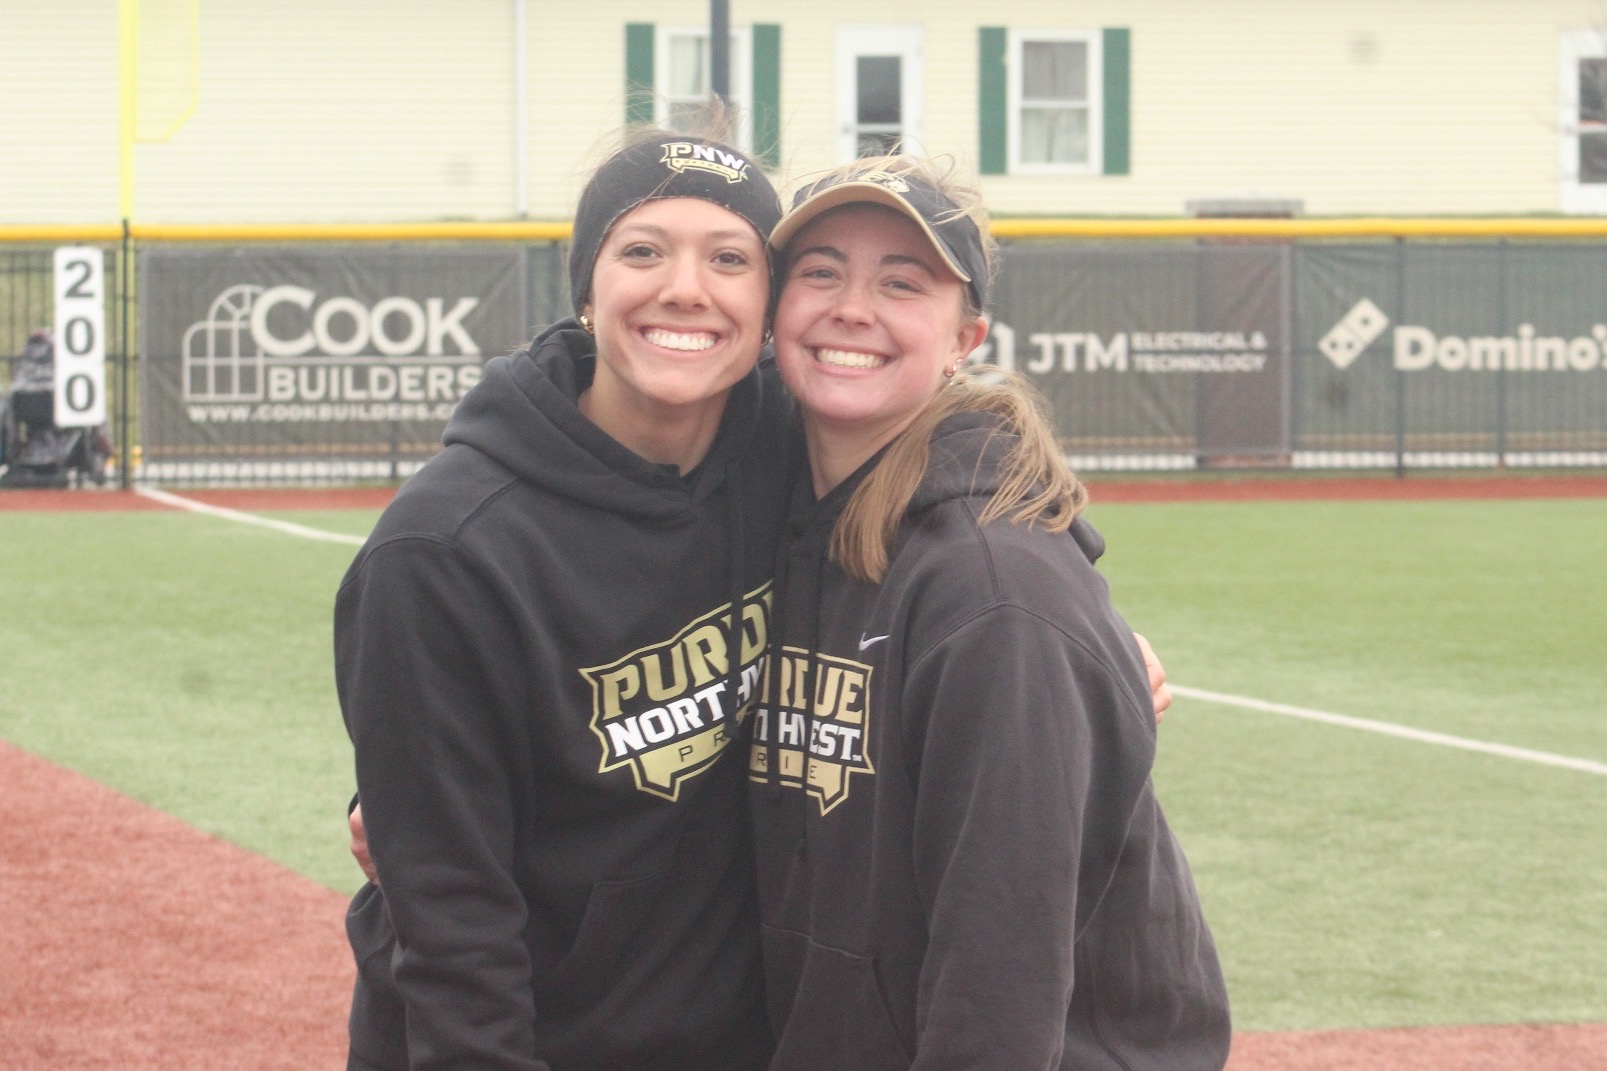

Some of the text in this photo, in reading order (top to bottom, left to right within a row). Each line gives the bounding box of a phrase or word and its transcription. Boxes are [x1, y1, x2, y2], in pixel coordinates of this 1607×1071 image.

[669, 144, 744, 170] PNW
[250, 286, 480, 355] COOK
[1027, 332, 1128, 374] JTM
[1131, 331, 1247, 349] ELECTRICAL
[1393, 323, 1607, 371] Domino'
[1133, 354, 1267, 372] TECHNOLOGY
[268, 366, 482, 400] BUILDERS
[188, 403, 456, 422] WWW.COOKBUILDERS.C
[600, 590, 774, 720] PURD
